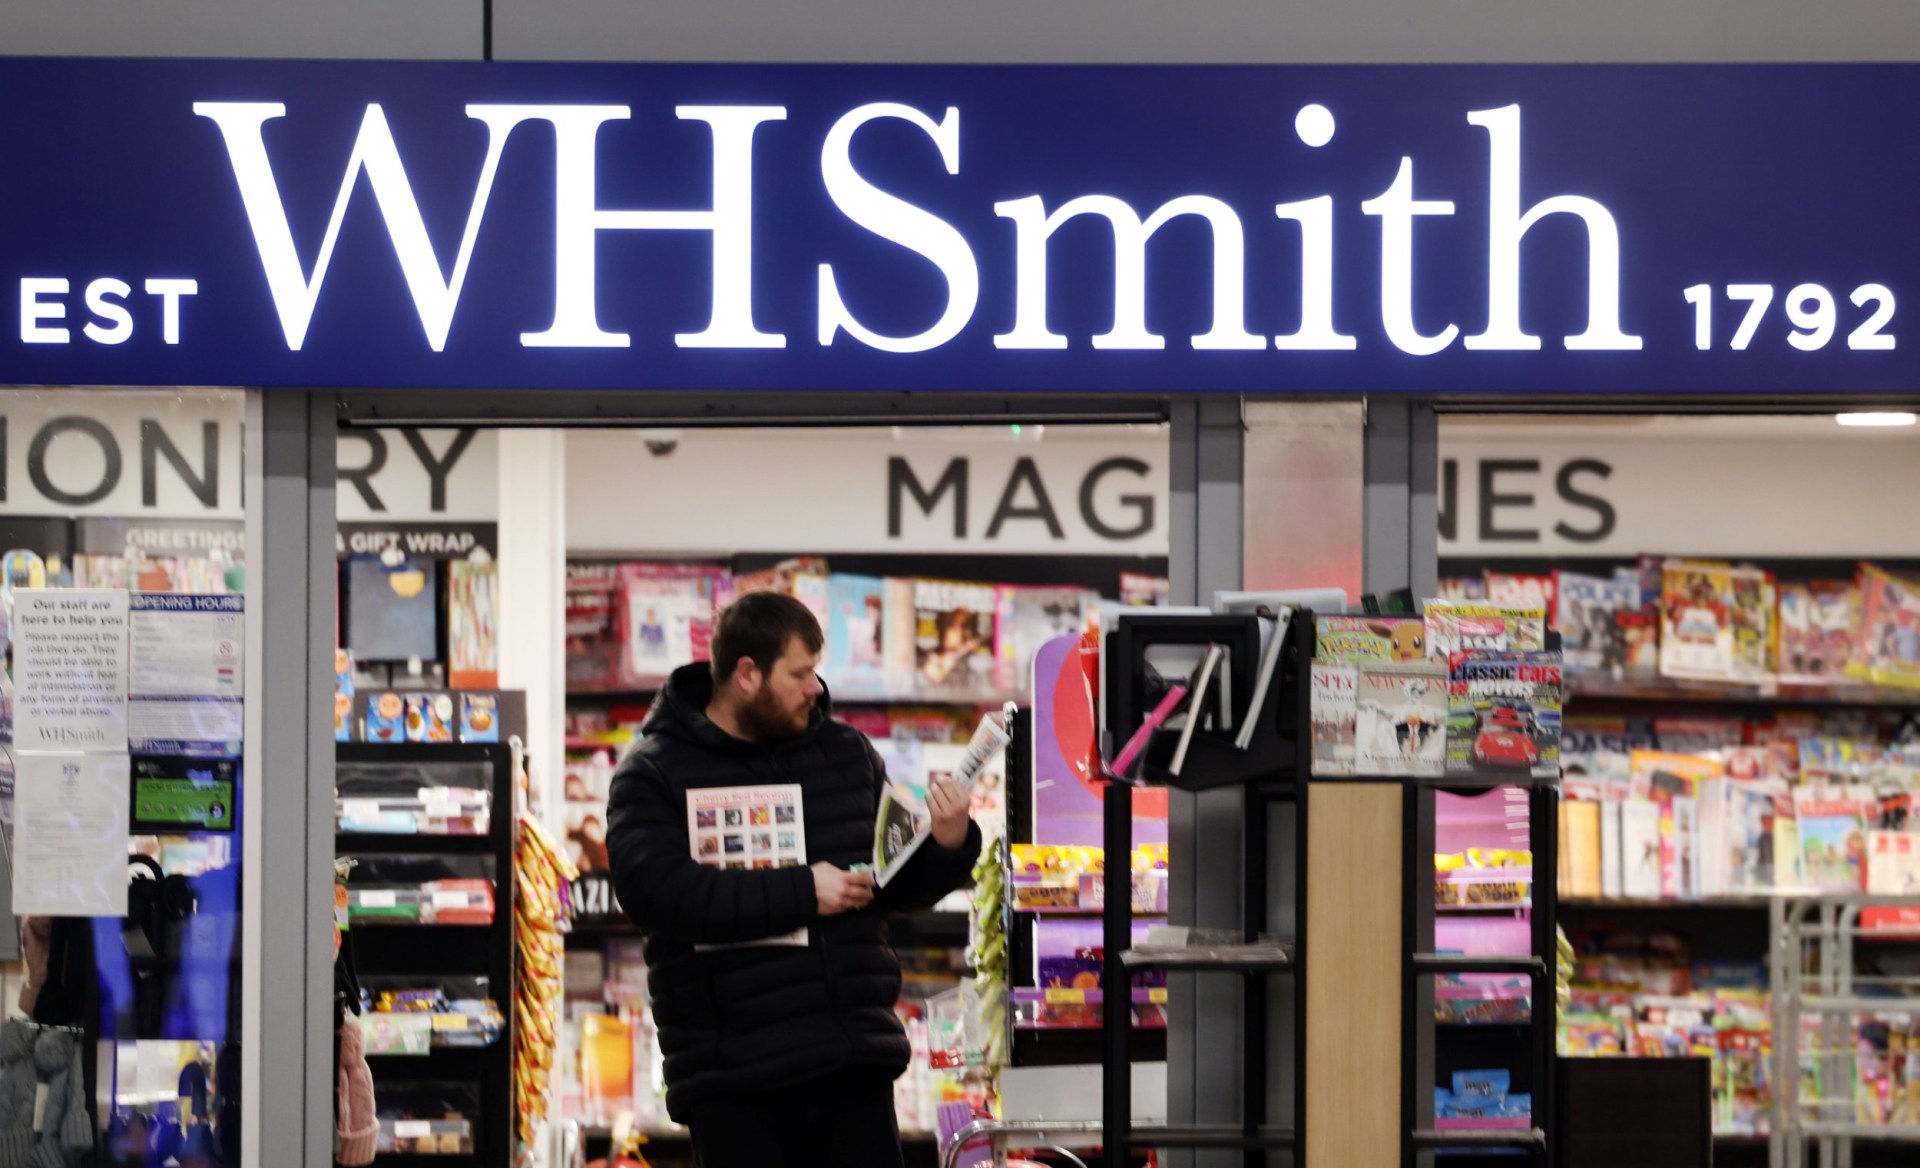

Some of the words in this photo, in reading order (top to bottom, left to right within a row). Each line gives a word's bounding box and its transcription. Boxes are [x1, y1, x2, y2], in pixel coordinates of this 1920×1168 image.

[193, 101, 1643, 355] WHSmith
[20, 277, 198, 345] EST
[1683, 283, 1896, 351] 1792
[887, 456, 1156, 541] MAG
[350, 532, 399, 553] GIFT
[406, 532, 475, 553] WRAP
[21, 614, 49, 625] here
[53, 615, 66, 625] to
[69, 614, 97, 627] help
[100, 616, 123, 627] you
[33, 599, 55, 610] Our
[60, 599, 88, 610] staff
[91, 601, 111, 610] are
[134, 595, 193, 610] OPENING
[195, 596, 241, 612] HOURS
